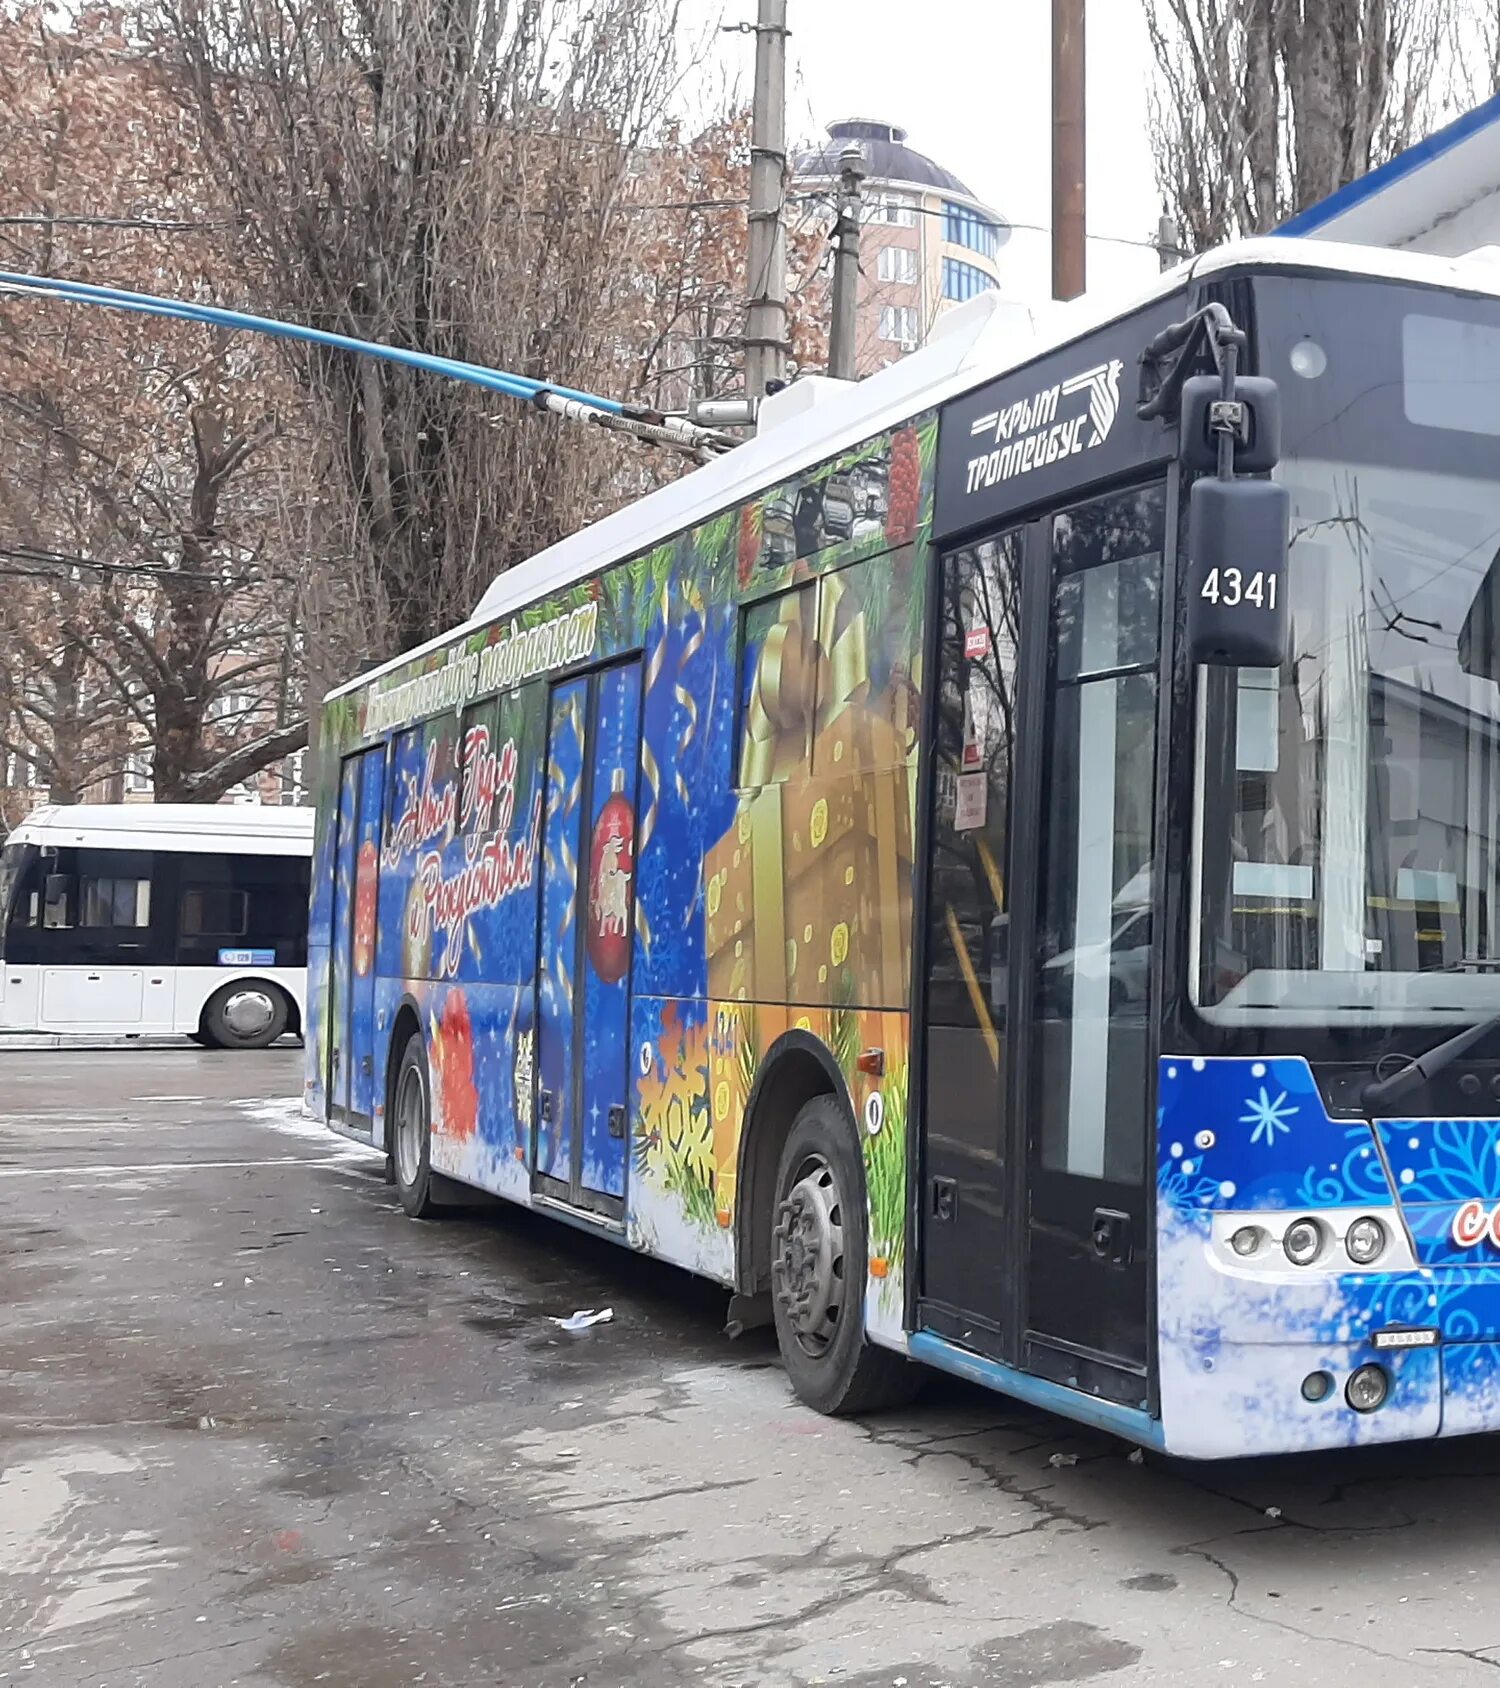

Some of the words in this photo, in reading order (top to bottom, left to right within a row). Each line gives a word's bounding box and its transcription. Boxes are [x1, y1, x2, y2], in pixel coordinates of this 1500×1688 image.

[995, 384, 1060, 444] КРЫМ
[967, 414, 1087, 494] ТРОЛЛЕЙБУС
[1201, 567, 1277, 610] 4341
[1451, 1199, 1490, 1247] с
